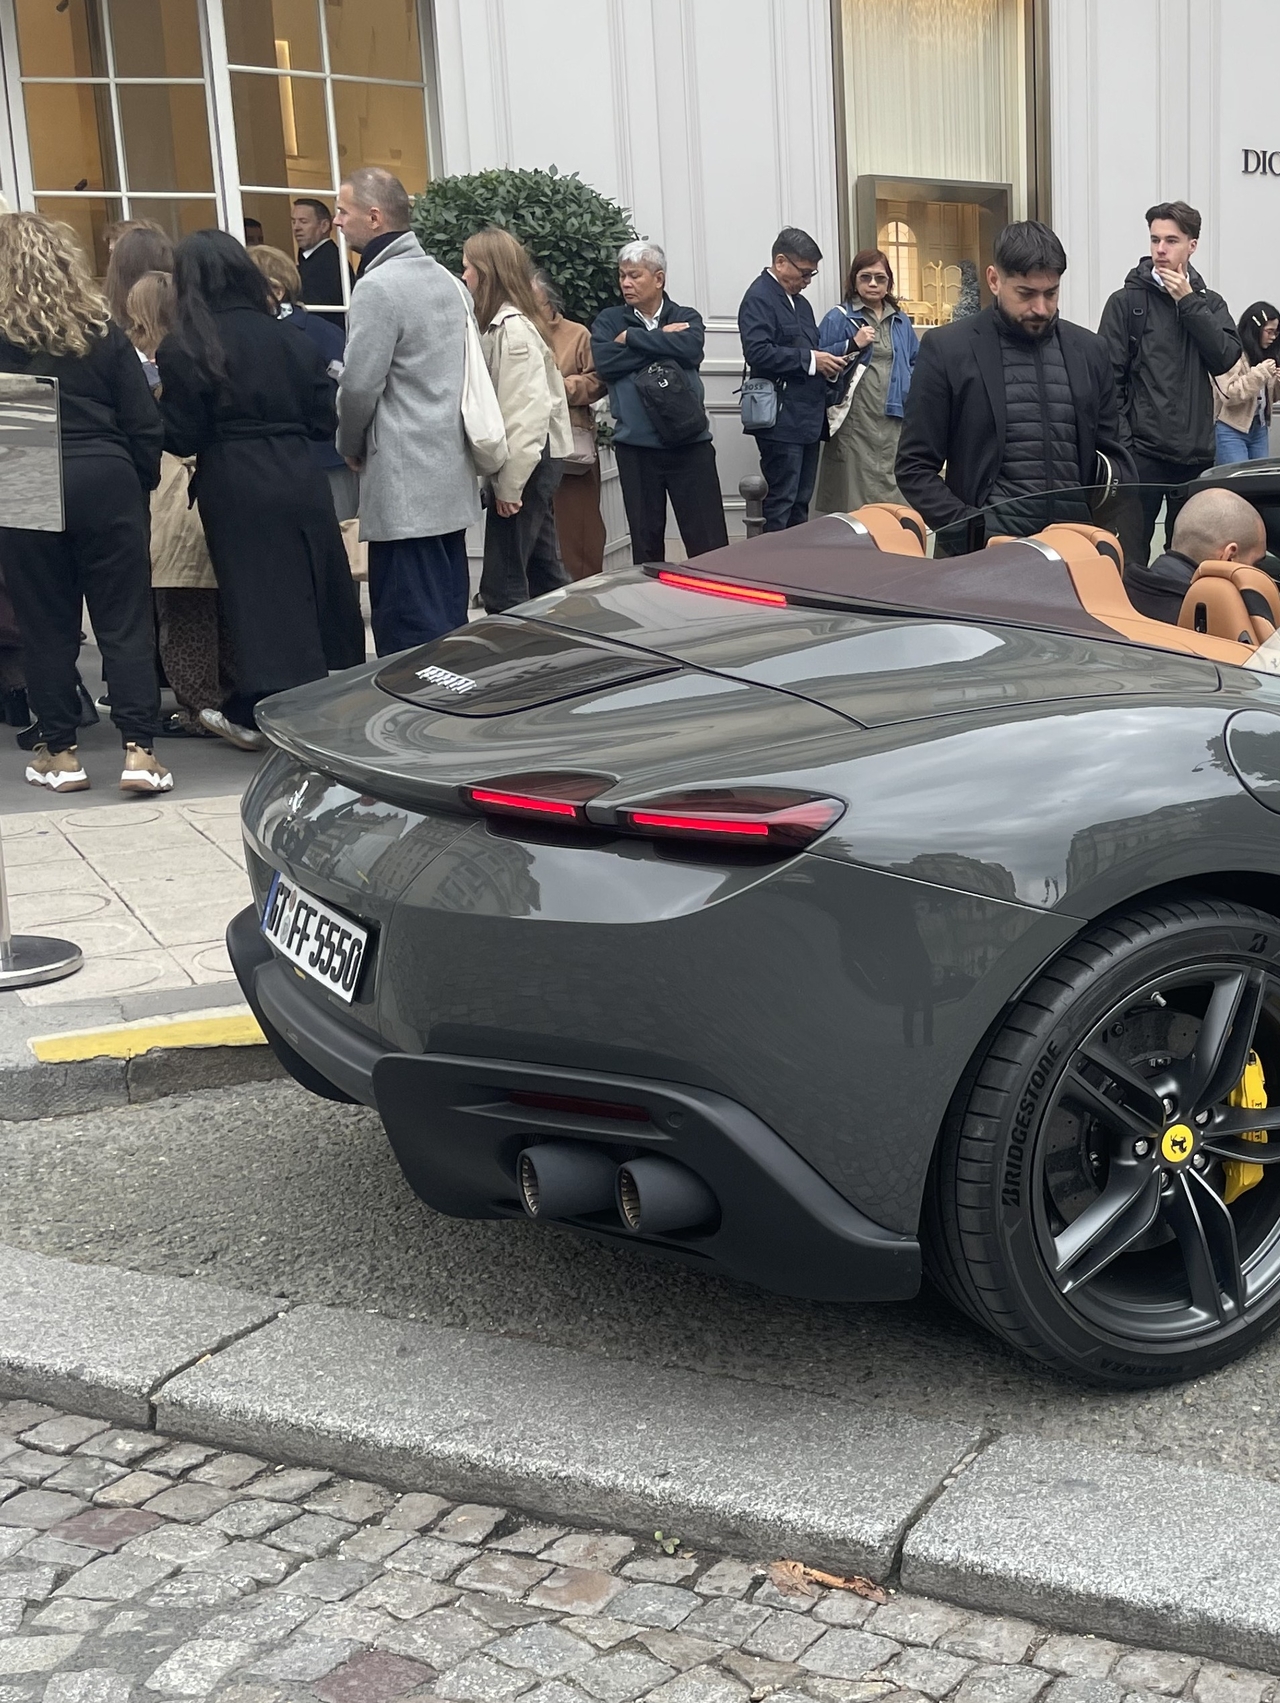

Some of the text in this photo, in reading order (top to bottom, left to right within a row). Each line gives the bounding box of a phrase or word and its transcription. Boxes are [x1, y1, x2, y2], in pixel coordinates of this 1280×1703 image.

[268, 882, 362, 992] GT FF 5550
[1002, 1040, 1062, 1207] BRIDGESTONE
